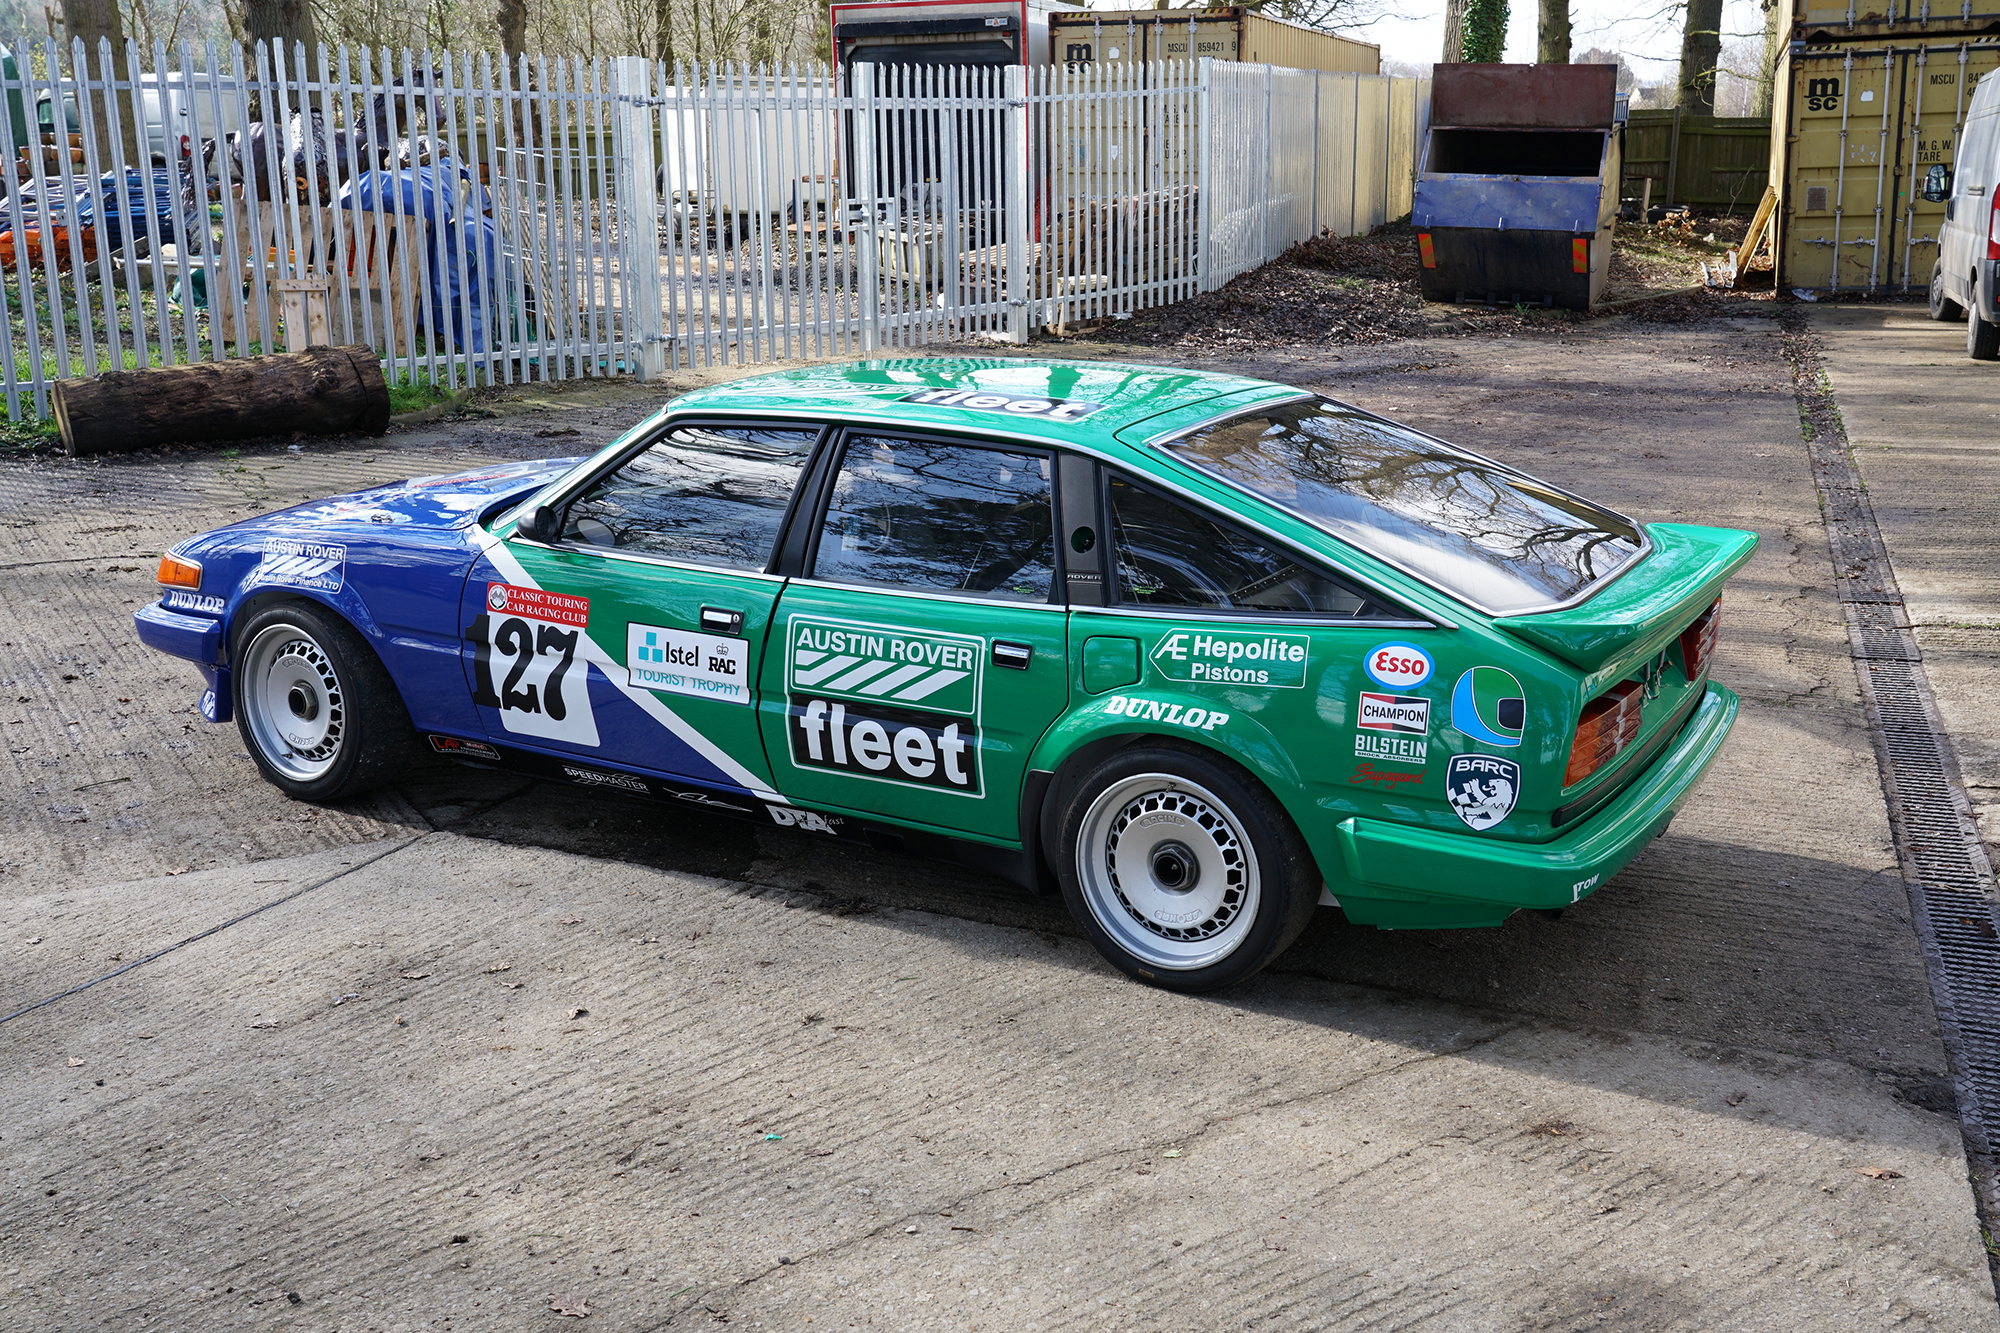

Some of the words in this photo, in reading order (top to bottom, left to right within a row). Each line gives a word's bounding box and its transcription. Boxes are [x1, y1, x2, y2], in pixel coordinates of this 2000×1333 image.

[1167, 43, 1188, 53] MSCU
[1197, 41, 1225, 52] 859421
[1231, 41, 1237, 52] 9
[1929, 74, 1955, 85] MSCU
[1918, 151, 1941, 162] TARE
[914, 390, 1088, 418] fleet
[265, 541, 304, 556] AUSTIN
[306, 545, 344, 560] ROVER
[323, 581, 339, 590] LTD
[168, 590, 225, 614] DUNLOP
[507, 588, 545, 604] CLASSIC
[546, 595, 588, 611] TOURING
[506, 601, 525, 613] CAR
[526, 605, 561, 620] RACING
[562, 611, 587, 624] CLUB
[665, 641, 699, 667] Istel
[796, 628, 884, 658] AUSTIN
[890, 639, 973, 670] ROVER
[1193, 635, 1305, 664] Hepolite
[465, 613, 579, 721] 127
[708, 656, 736, 675] RAC
[1191, 663, 1269, 684] Pistons
[636, 668, 686, 687] TOURIST
[689, 677, 740, 696] TROPHY
[1104, 695, 1229, 731] DUNLOP
[1363, 704, 1425, 723] CHAMPION
[800, 699, 968, 785] fleet
[1355, 734, 1427, 758] BILSTEIN
[1382, 754, 1423, 763] ABSORBERS
[1455, 759, 1513, 780] BARC
[563, 767, 650, 792] SPEEDMASTER
[1348, 762, 1427, 790] Supagard
[1577, 872, 1600, 892] TOW
